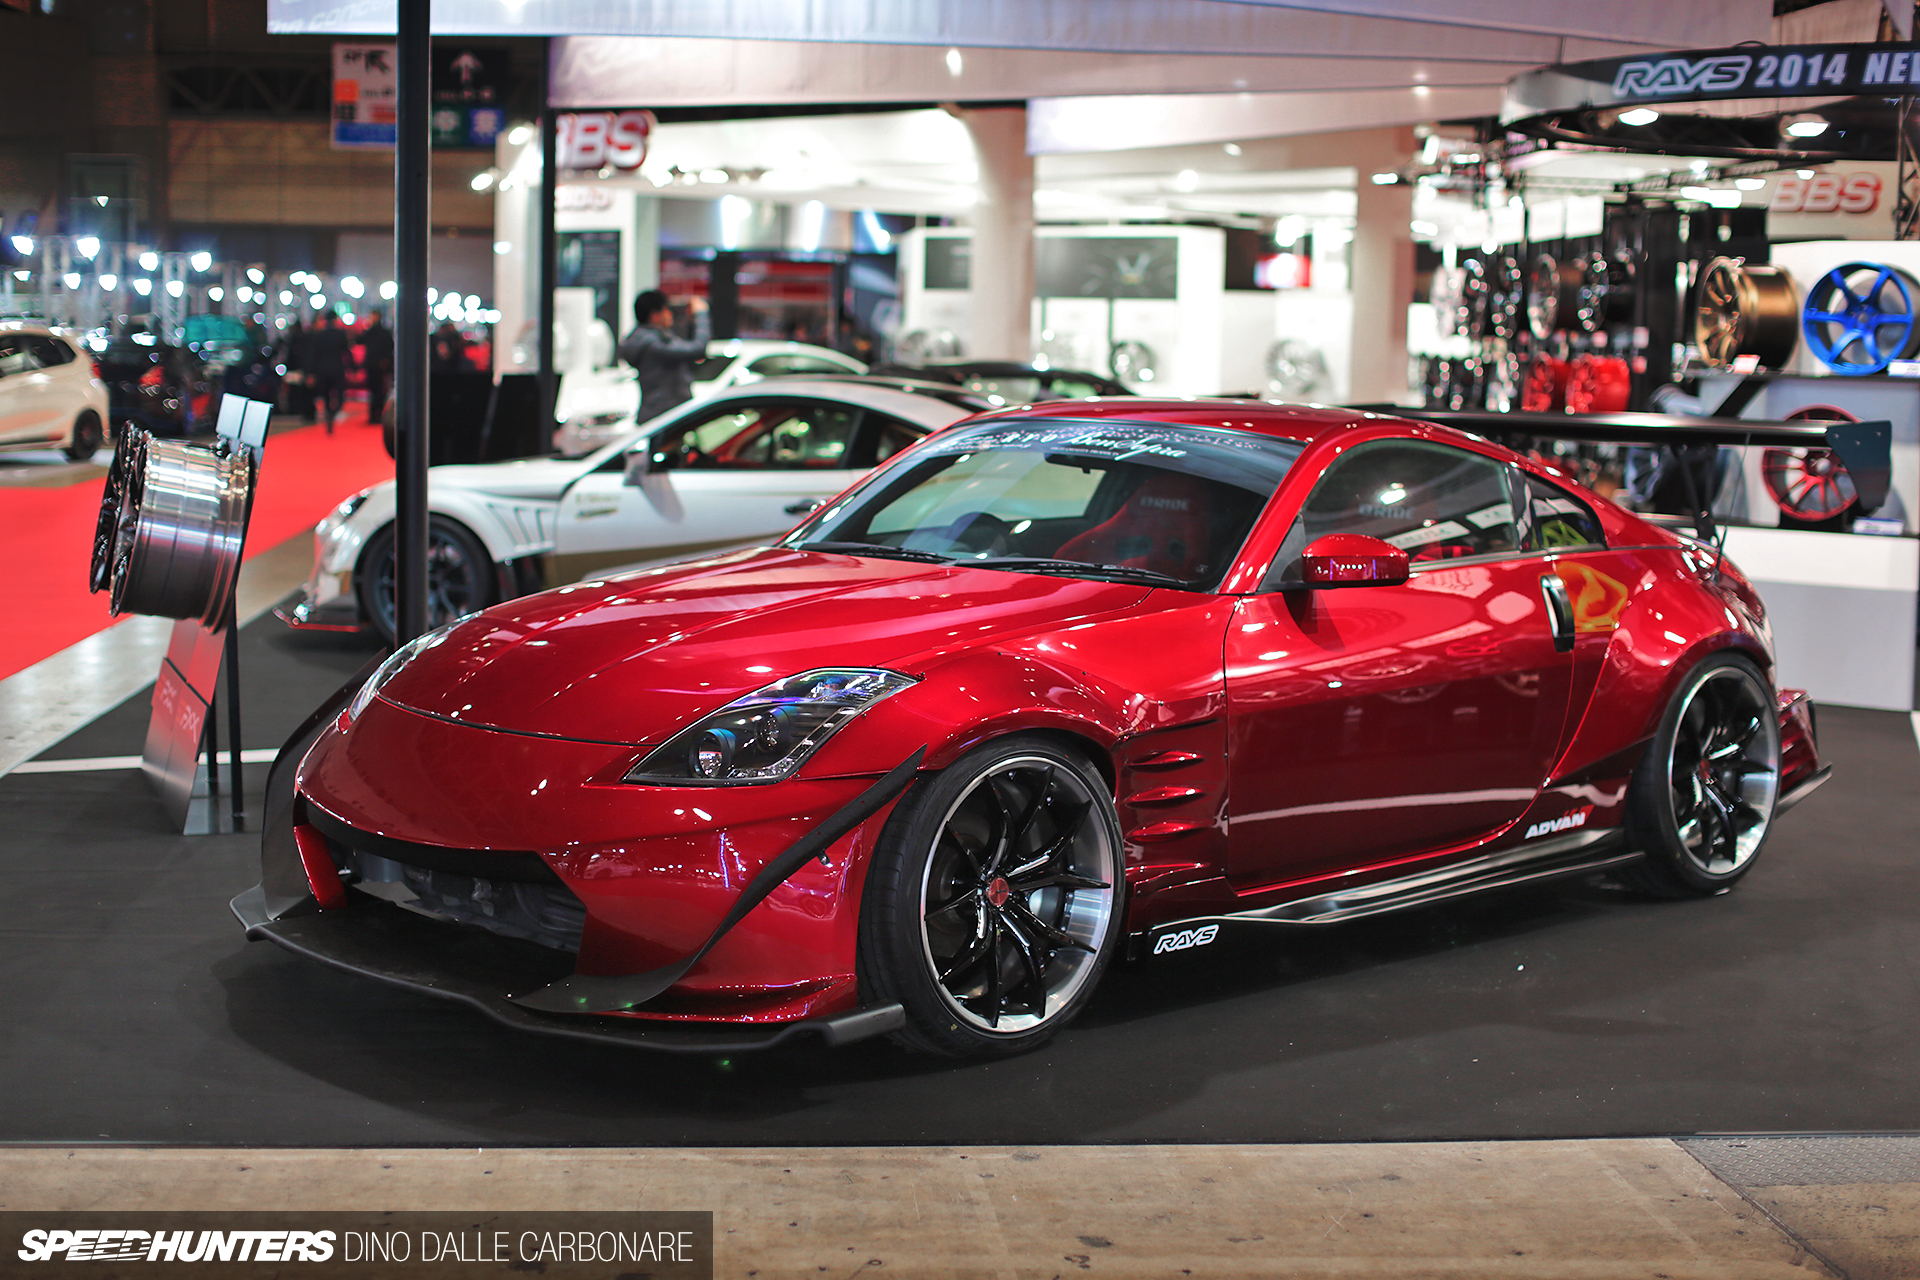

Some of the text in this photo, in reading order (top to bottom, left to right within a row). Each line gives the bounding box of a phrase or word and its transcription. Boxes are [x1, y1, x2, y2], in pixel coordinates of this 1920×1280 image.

[1612, 52, 1920, 98] RAYS 2014 NE
[1767, 172, 1882, 213] BBS
[1358, 504, 1416, 520] BRIDE
[1524, 812, 1586, 839] ADVAN
[1153, 924, 1219, 955] RAYS
